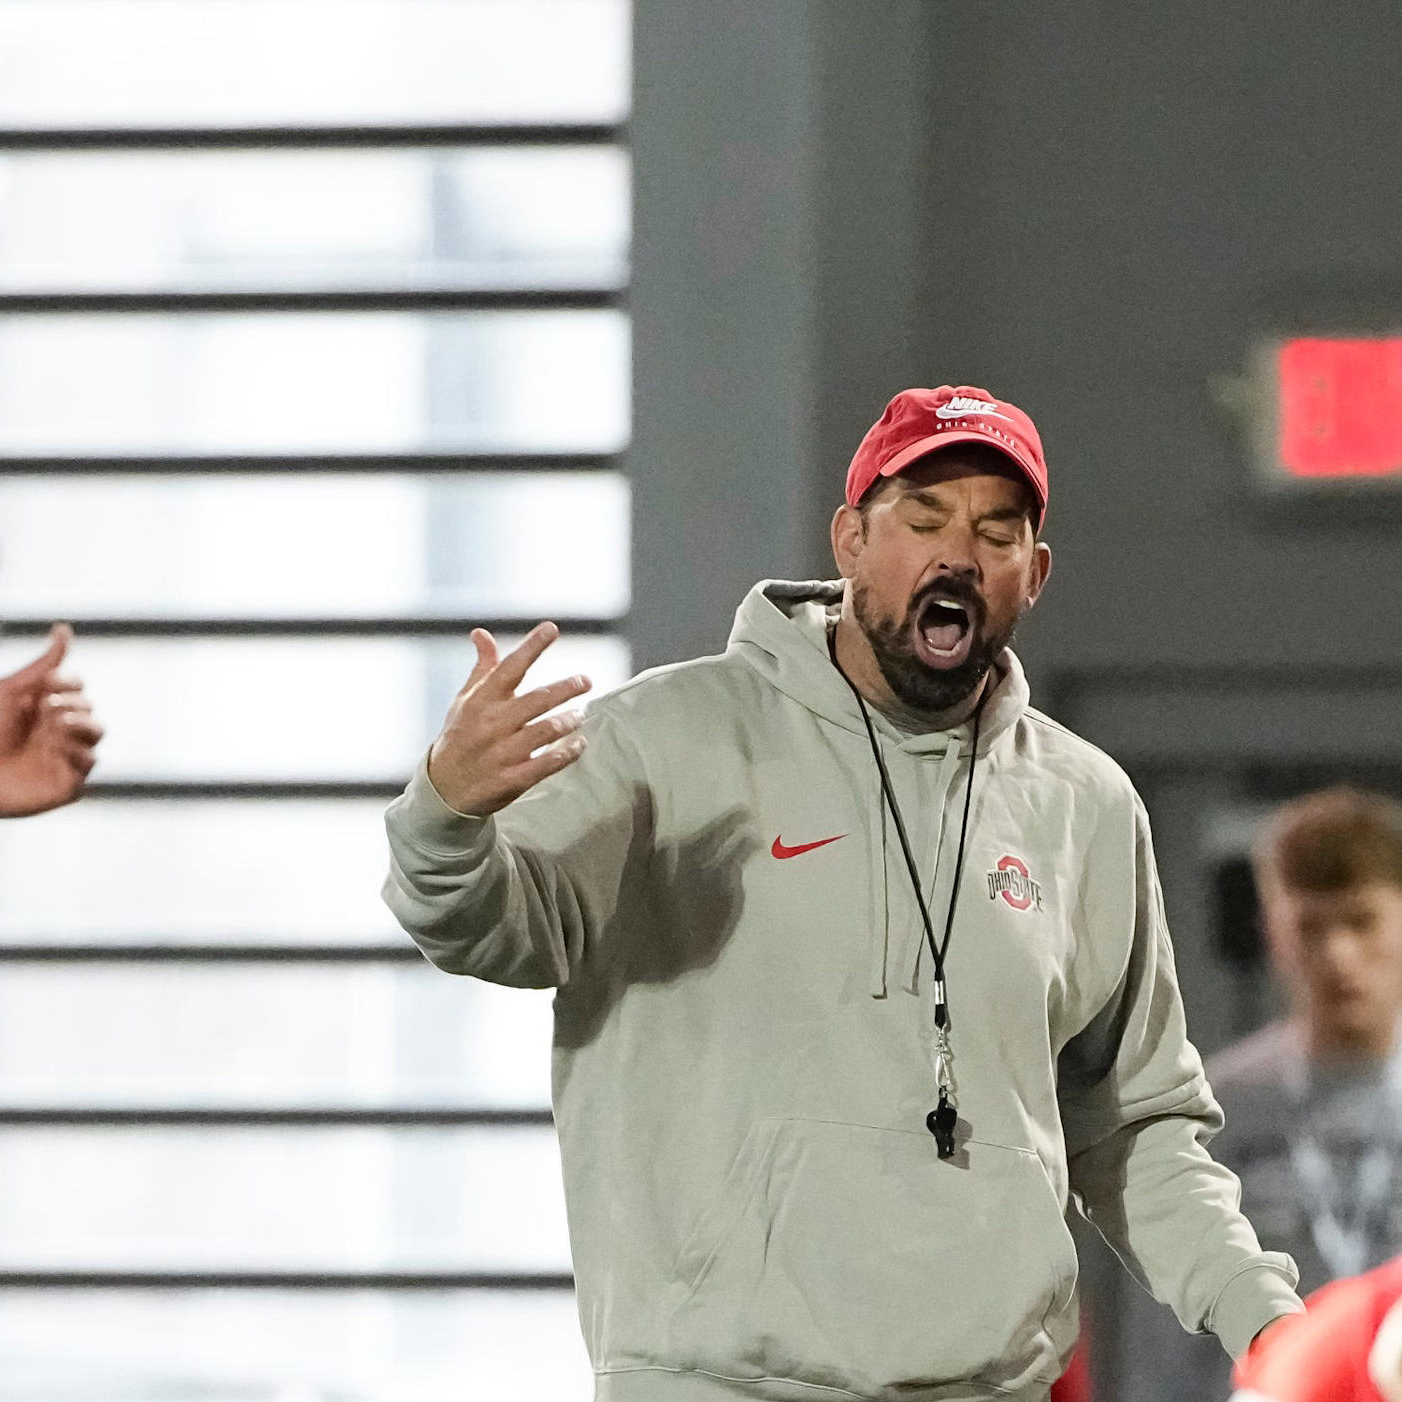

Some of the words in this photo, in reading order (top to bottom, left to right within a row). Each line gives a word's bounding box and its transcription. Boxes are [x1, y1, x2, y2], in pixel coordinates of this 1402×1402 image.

[947, 396, 998, 412] NIKE
[936, 421, 968, 430] OHIO
[987, 871, 1011, 900] OHIO
[1010, 869, 1043, 912] STATE
